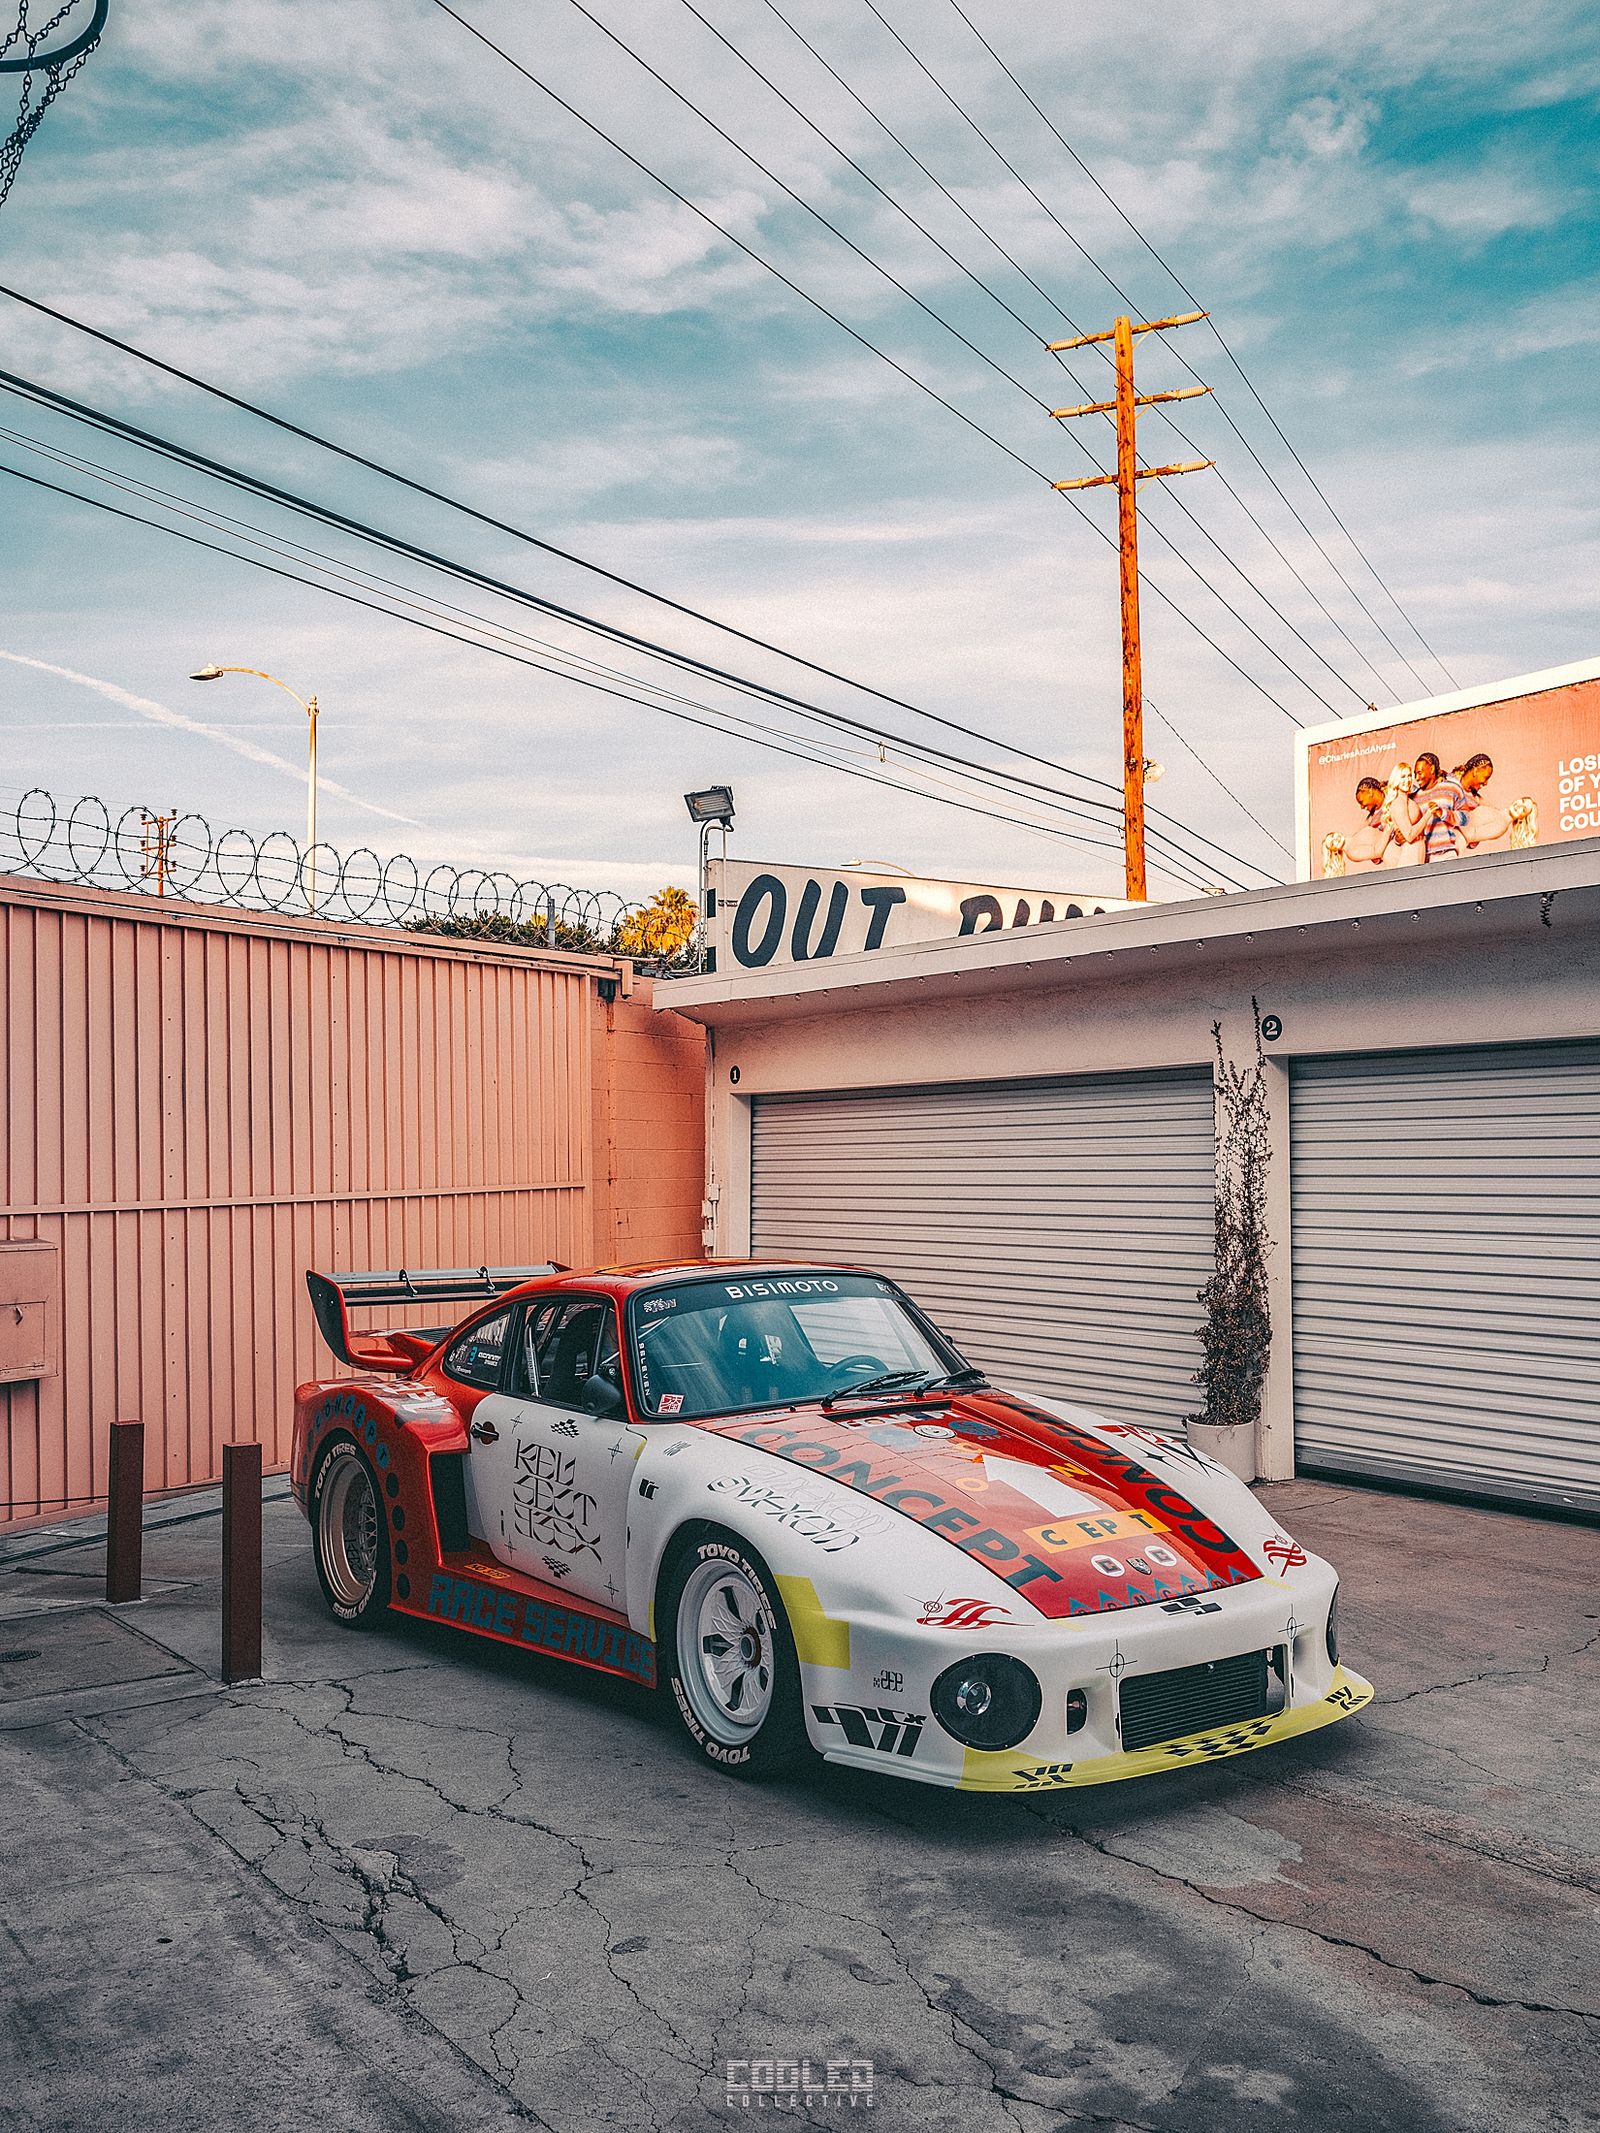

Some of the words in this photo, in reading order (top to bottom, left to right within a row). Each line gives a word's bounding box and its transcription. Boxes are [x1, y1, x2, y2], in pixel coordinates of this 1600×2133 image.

[1558, 753, 1600, 776] LOS
[1558, 775, 1585, 794] OF
[1559, 791, 1600, 813] FOL
[732, 873, 906, 968] OUT
[1266, 1020, 1278, 1035] 2
[725, 1280, 839, 1299] BISIMOTO
[314, 1453, 332, 1499] TOYO
[331, 1442, 356, 1458] TIRES
[740, 1427, 1063, 1592] CONCEPT
[697, 1543, 740, 1564] TOYO
[741, 1558, 777, 1630] TIRES
[332, 1602, 358, 1619] TIRES
[427, 1573, 517, 1635] RACE
[521, 1601, 655, 1681] SERVICE
[670, 1677, 706, 1746] TIRES
[706, 1741, 750, 1764] TOYO
